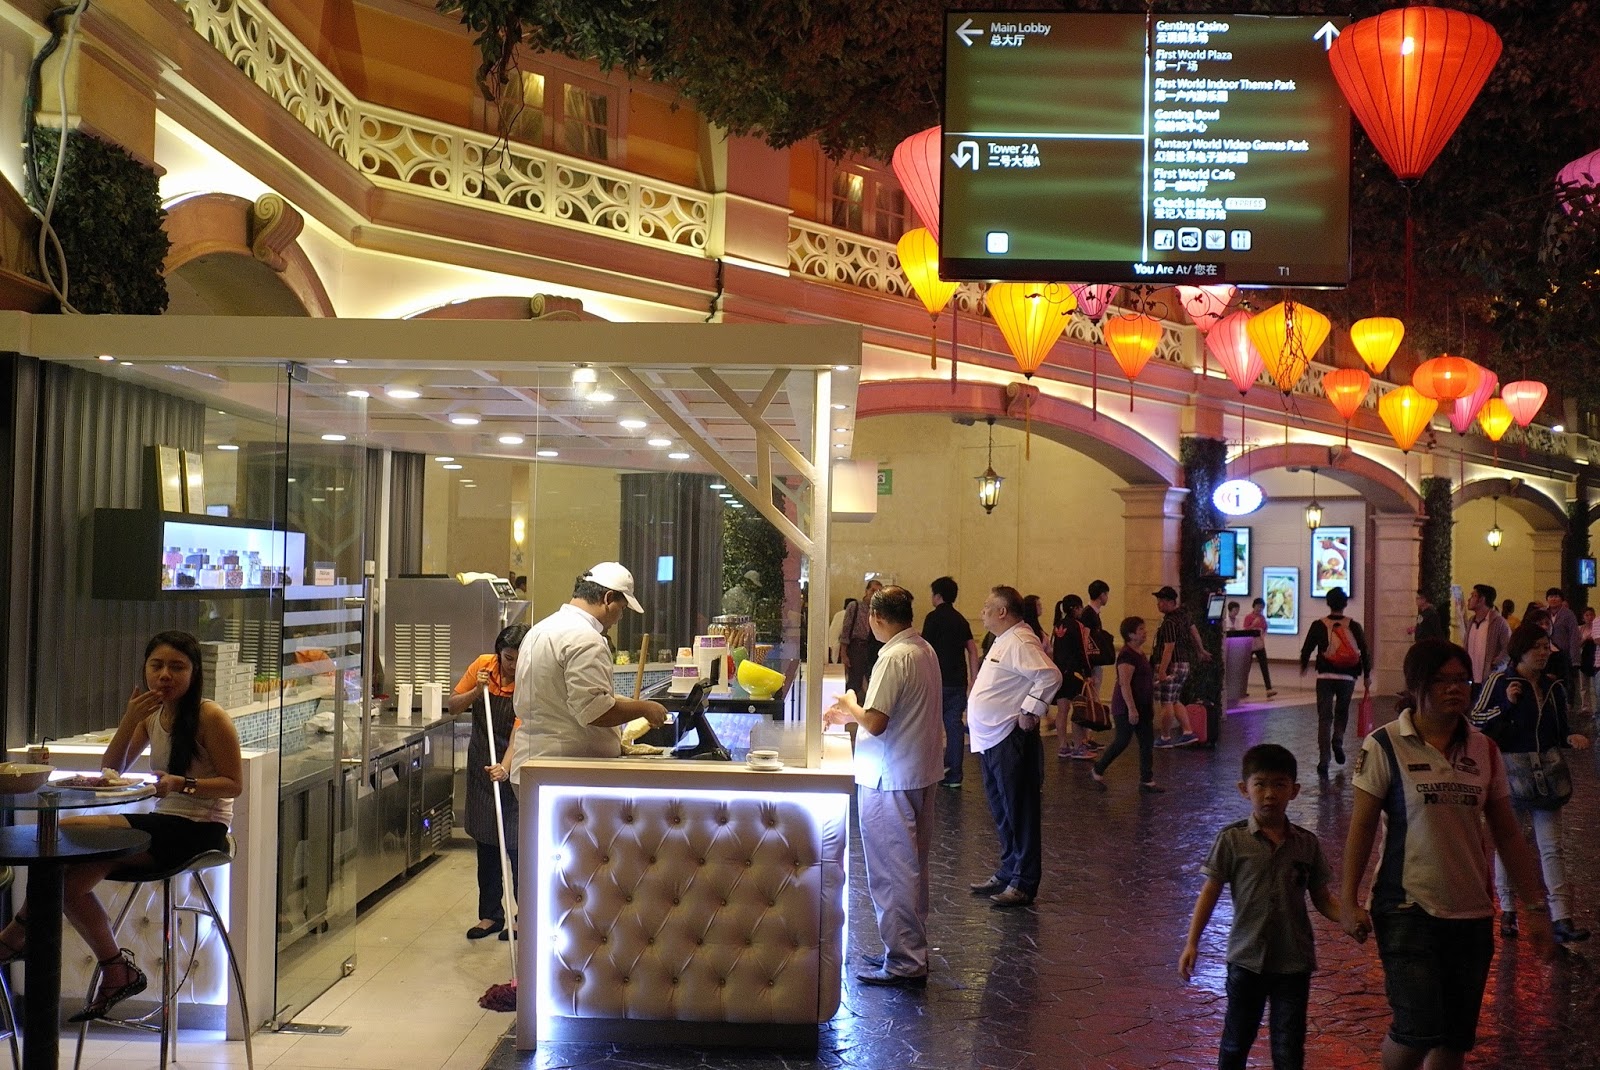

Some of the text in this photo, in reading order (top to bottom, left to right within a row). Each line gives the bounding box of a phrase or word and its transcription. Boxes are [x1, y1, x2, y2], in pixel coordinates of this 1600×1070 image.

[990, 22, 1051, 36] Main Lobby
[1156, 21, 1229, 33] Genting Casino
[990, 34, 1025, 46] 总大厅
[1156, 49, 1233, 60] First World Plaza
[1155, 60, 1198, 71] 第一广场
[1155, 78, 1296, 91] First World Indoor Theme Park
[1154, 109, 1220, 121] Genting Bowl
[987, 143, 1039, 155] Tower 2 A
[1154, 138, 1309, 151] Funtasy World Video Games Park
[1154, 168, 1236, 180] First World Cafe
[1153, 197, 1184, 208] Check
[1196, 198, 1223, 209] Kiosk
[1228, 200, 1263, 208] EXPRESS
[1133, 263, 1218, 276] You Are At/ 您在
[1278, 266, 1290, 276] T1
[1416, 782, 1482, 795] CHAMPIONSHIP
